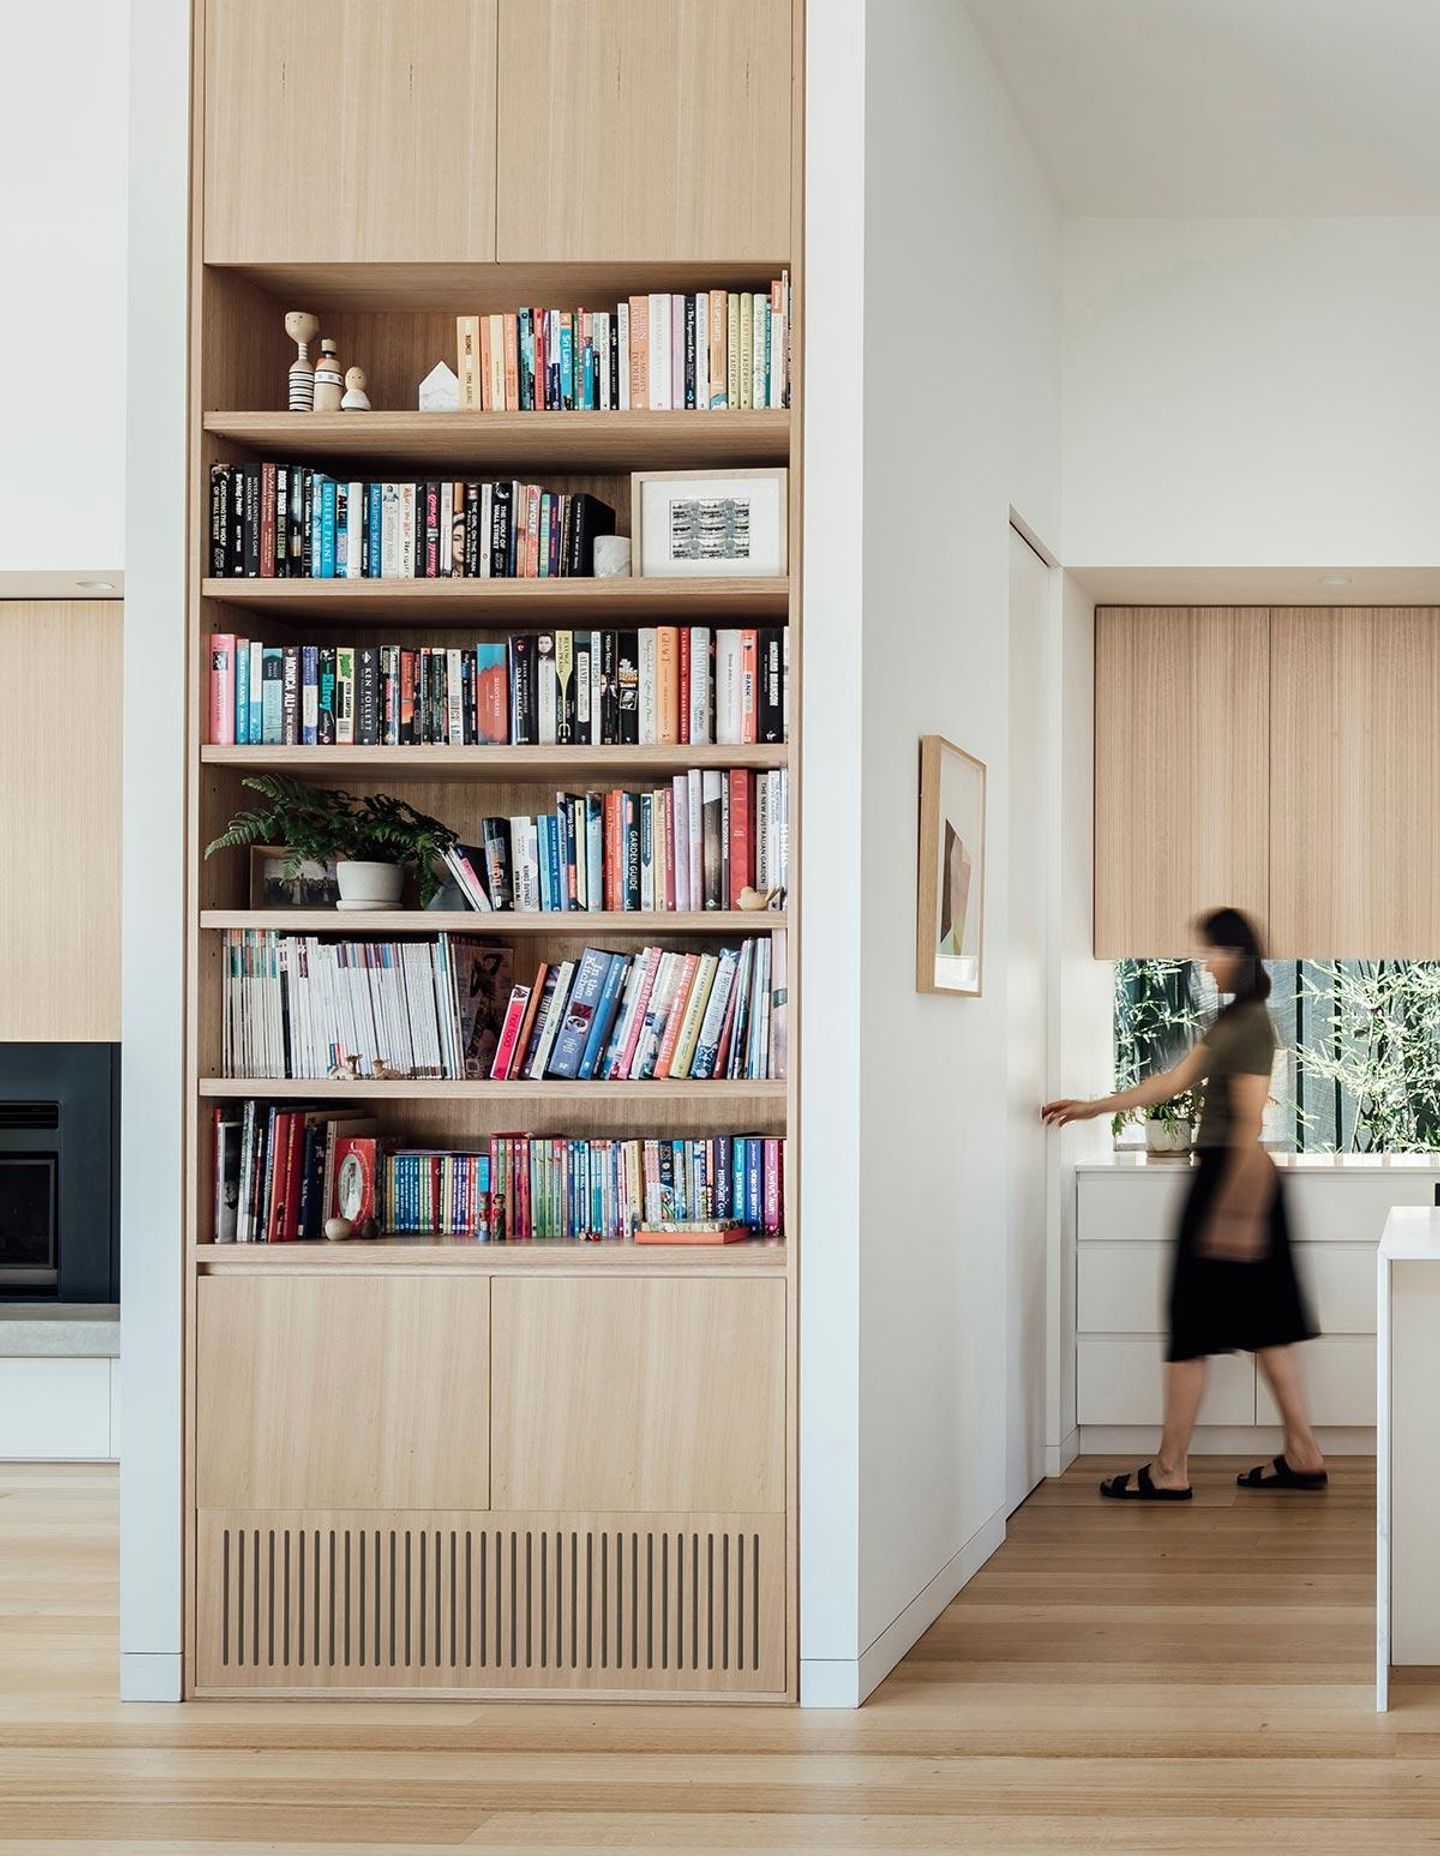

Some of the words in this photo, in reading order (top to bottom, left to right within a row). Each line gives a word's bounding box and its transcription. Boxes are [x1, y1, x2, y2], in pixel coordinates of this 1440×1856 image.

[563, 335, 572, 347] Sri
[563, 349, 572, 373] Lanka
[213, 486, 219, 495] OF
[324, 487, 332, 525] ROBERT
[324, 531, 332, 563] PLANT
[471, 530, 477, 540] ON
[501, 539, 506, 549] OF
[285, 657, 296, 690] MONICA
[580, 656, 589, 687] ATLANTIC
[694, 638, 706, 704] INNOVATORS
[285, 692, 296, 707] ALI
[319, 674, 334, 711] Ellroy
[629, 830, 638, 864] GARDEN
[629, 865, 638, 891] GUIDE
